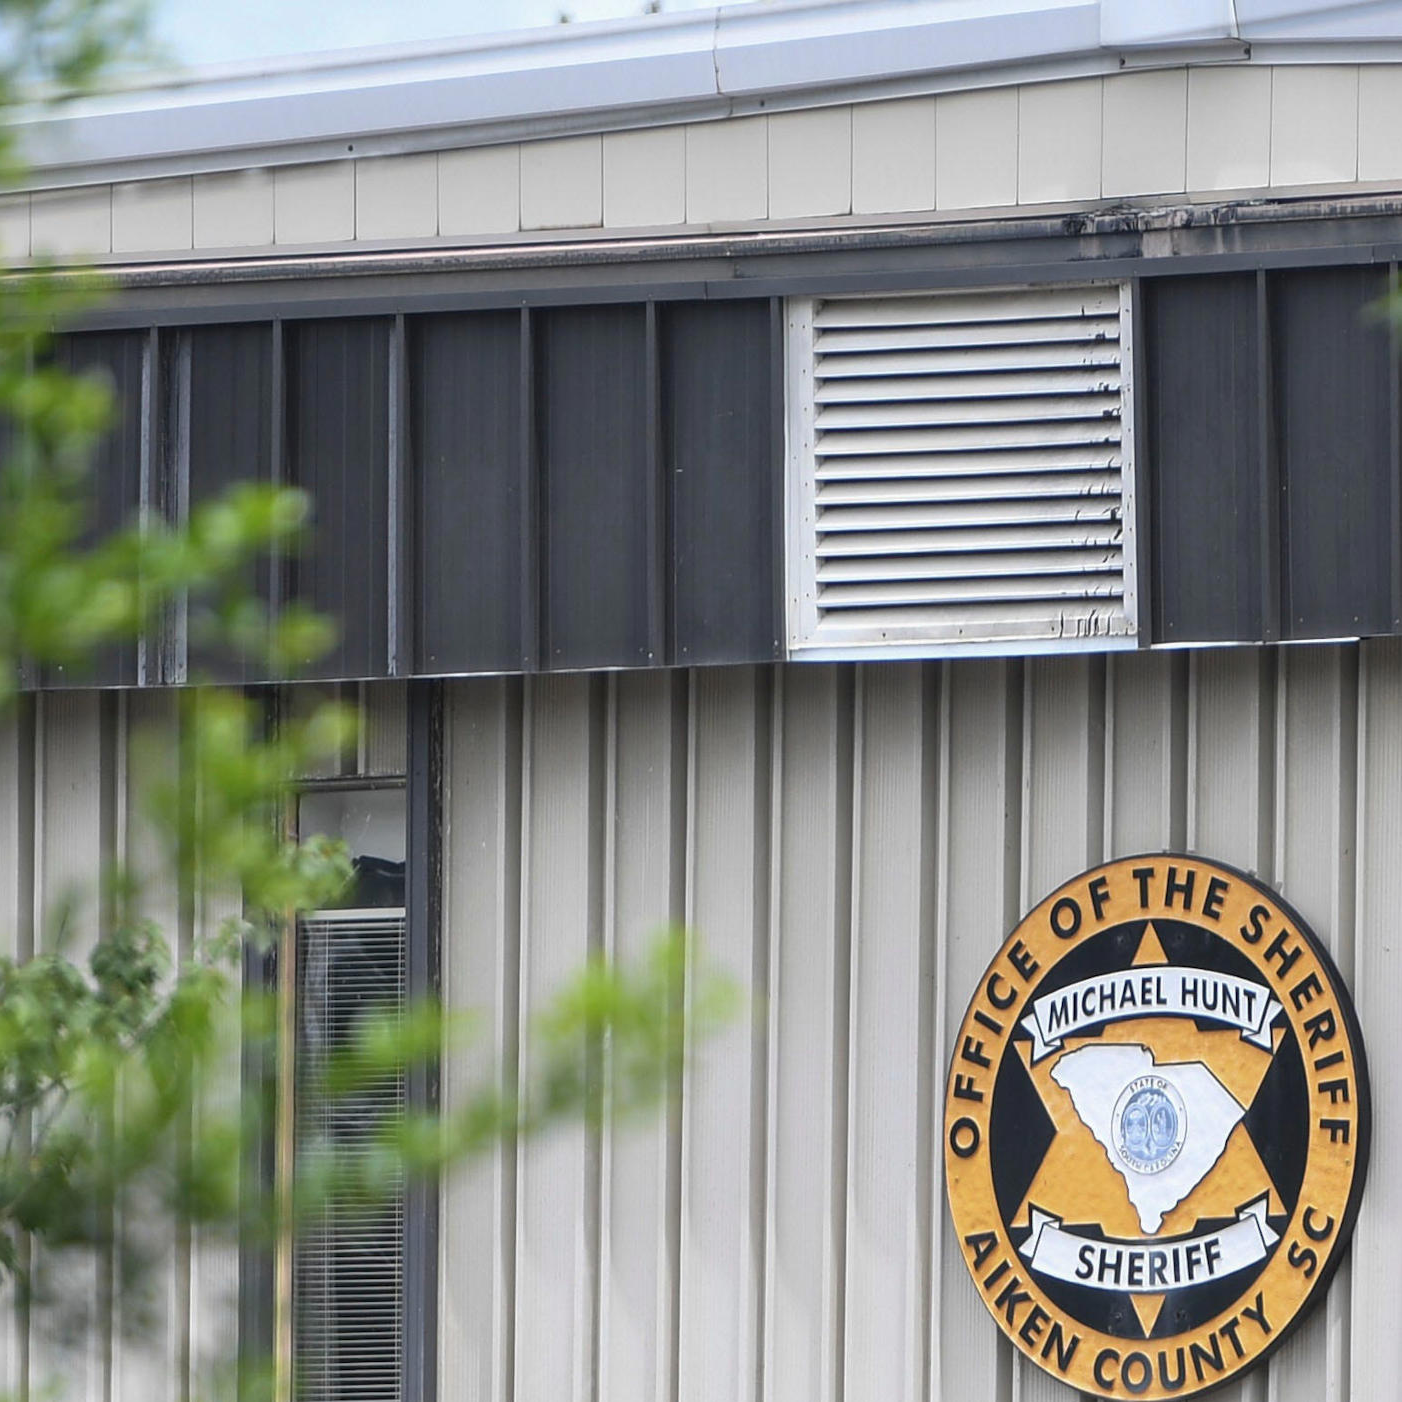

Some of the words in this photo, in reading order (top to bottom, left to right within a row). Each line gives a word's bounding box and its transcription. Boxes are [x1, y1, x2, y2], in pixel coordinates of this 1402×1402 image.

[949, 939, 1040, 1160] OFFICE
[1049, 876, 1111, 940] OF
[1132, 866, 1229, 922] THE
[1239, 905, 1351, 1146] SHERIFF
[1048, 976, 1167, 1033] MICHAEL
[1181, 976, 1258, 1023] HUNT
[1129, 1078, 1154, 1093] STATE
[1075, 1238, 1222, 1286] SHERIFF
[964, 1231, 1080, 1373] AIKEN
[1093, 1291, 1272, 1391] COUNTY
[1288, 1206, 1335, 1279] SC
